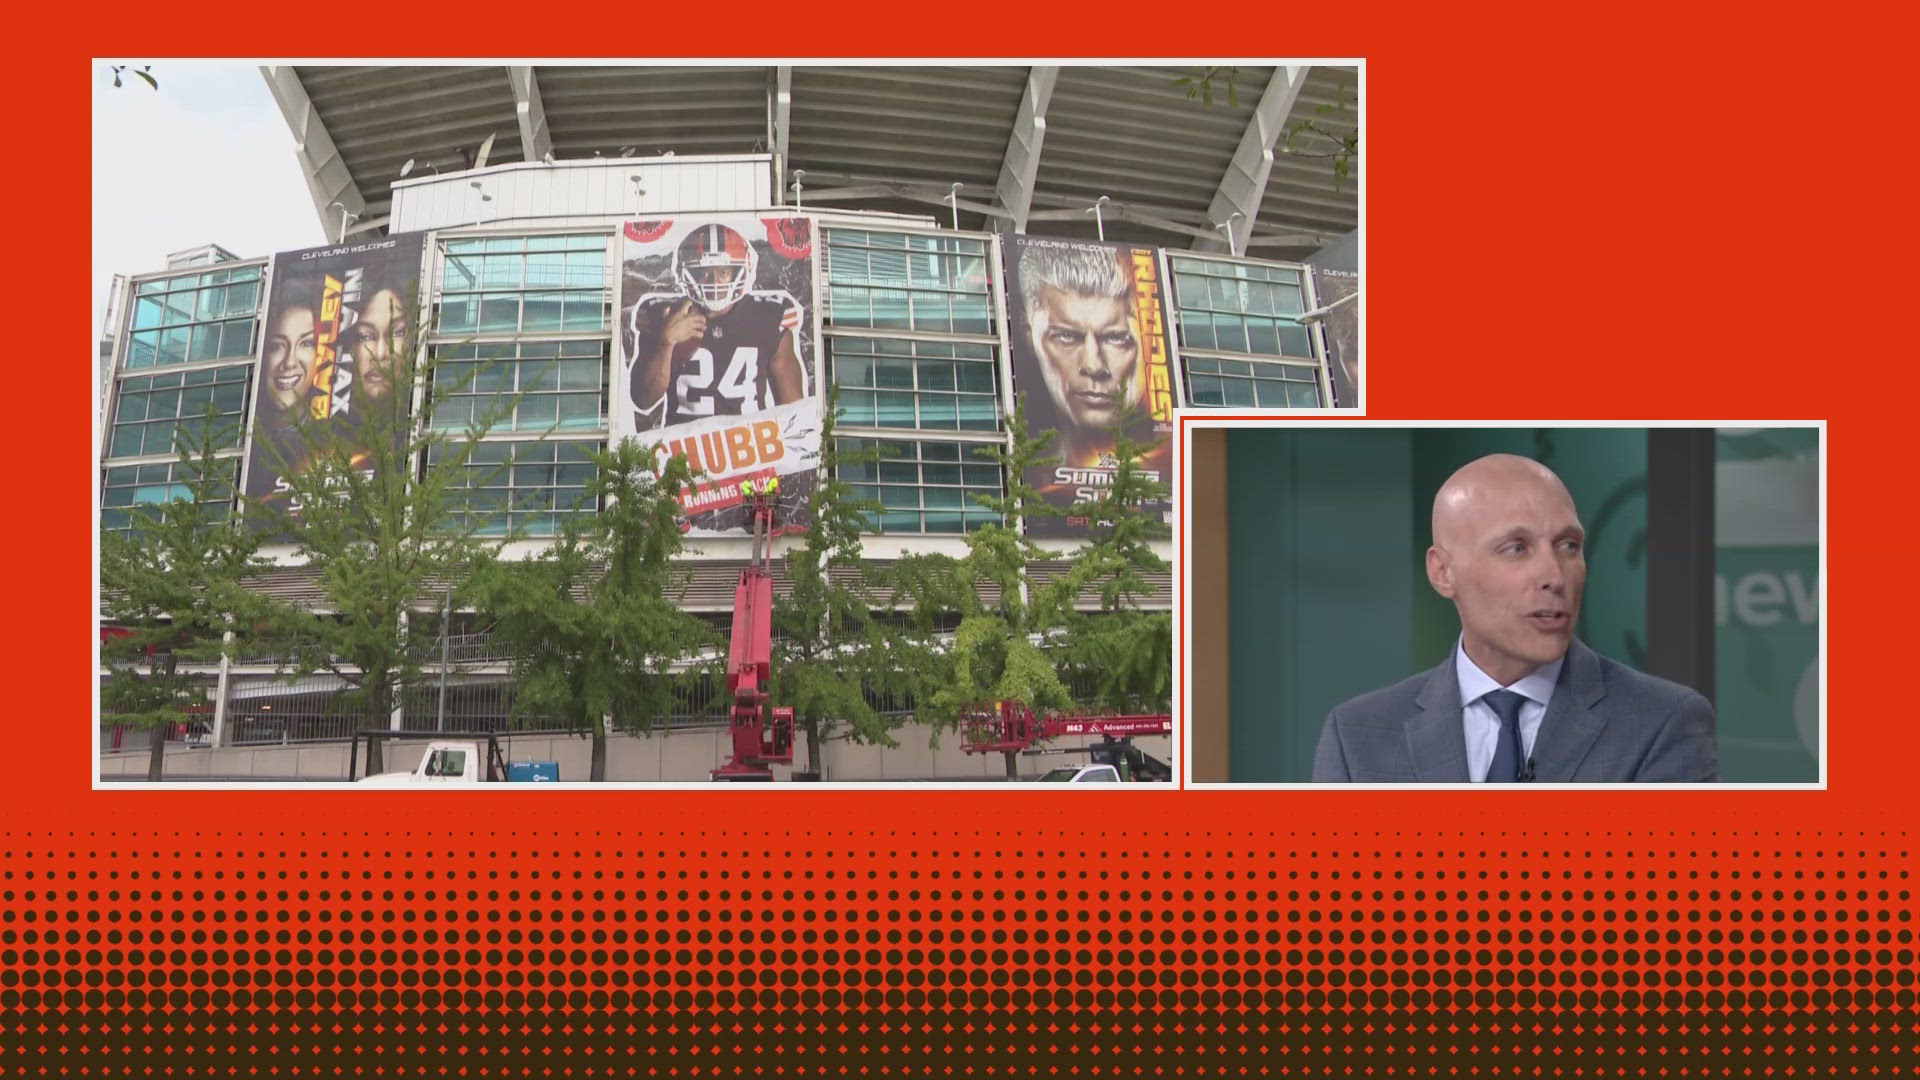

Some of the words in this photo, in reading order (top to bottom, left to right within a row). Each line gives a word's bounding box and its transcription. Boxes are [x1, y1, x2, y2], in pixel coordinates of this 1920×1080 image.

[301, 247, 349, 260] CLEVELAND
[350, 240, 397, 252] WELCOMES
[1017, 239, 1069, 249] CLEVELAND
[1132, 253, 1173, 422] RHODES
[676, 347, 758, 415] 24
[683, 484, 738, 508] RUNNING
[740, 476, 771, 497] ACK
[1066, 516, 1091, 526] SAT
[1103, 723, 1135, 731] Advanced
